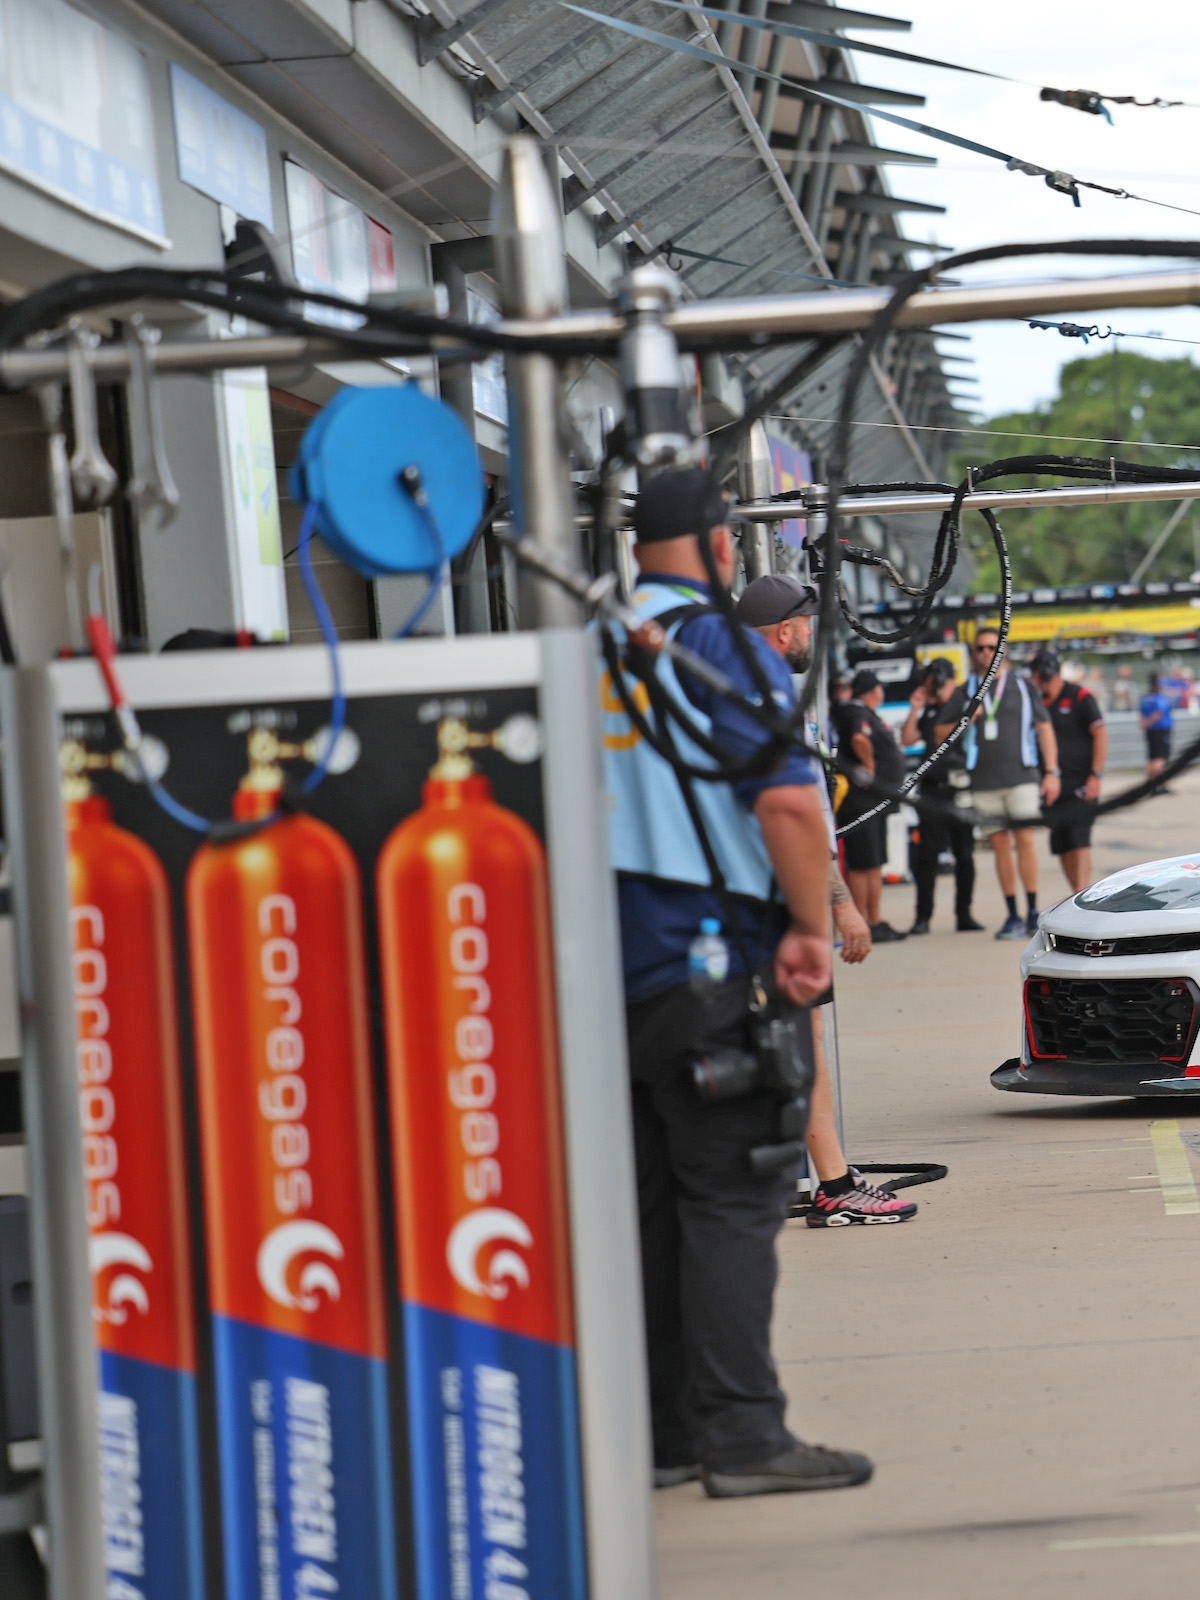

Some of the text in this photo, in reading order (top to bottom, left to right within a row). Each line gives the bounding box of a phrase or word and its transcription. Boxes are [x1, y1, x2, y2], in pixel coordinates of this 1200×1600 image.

[256, 892, 313, 1216] coregas
[447, 881, 502, 1203] coregas
[285, 1375, 338, 1564] NITROGEN
[474, 1363, 528, 1550] NITROGEN
